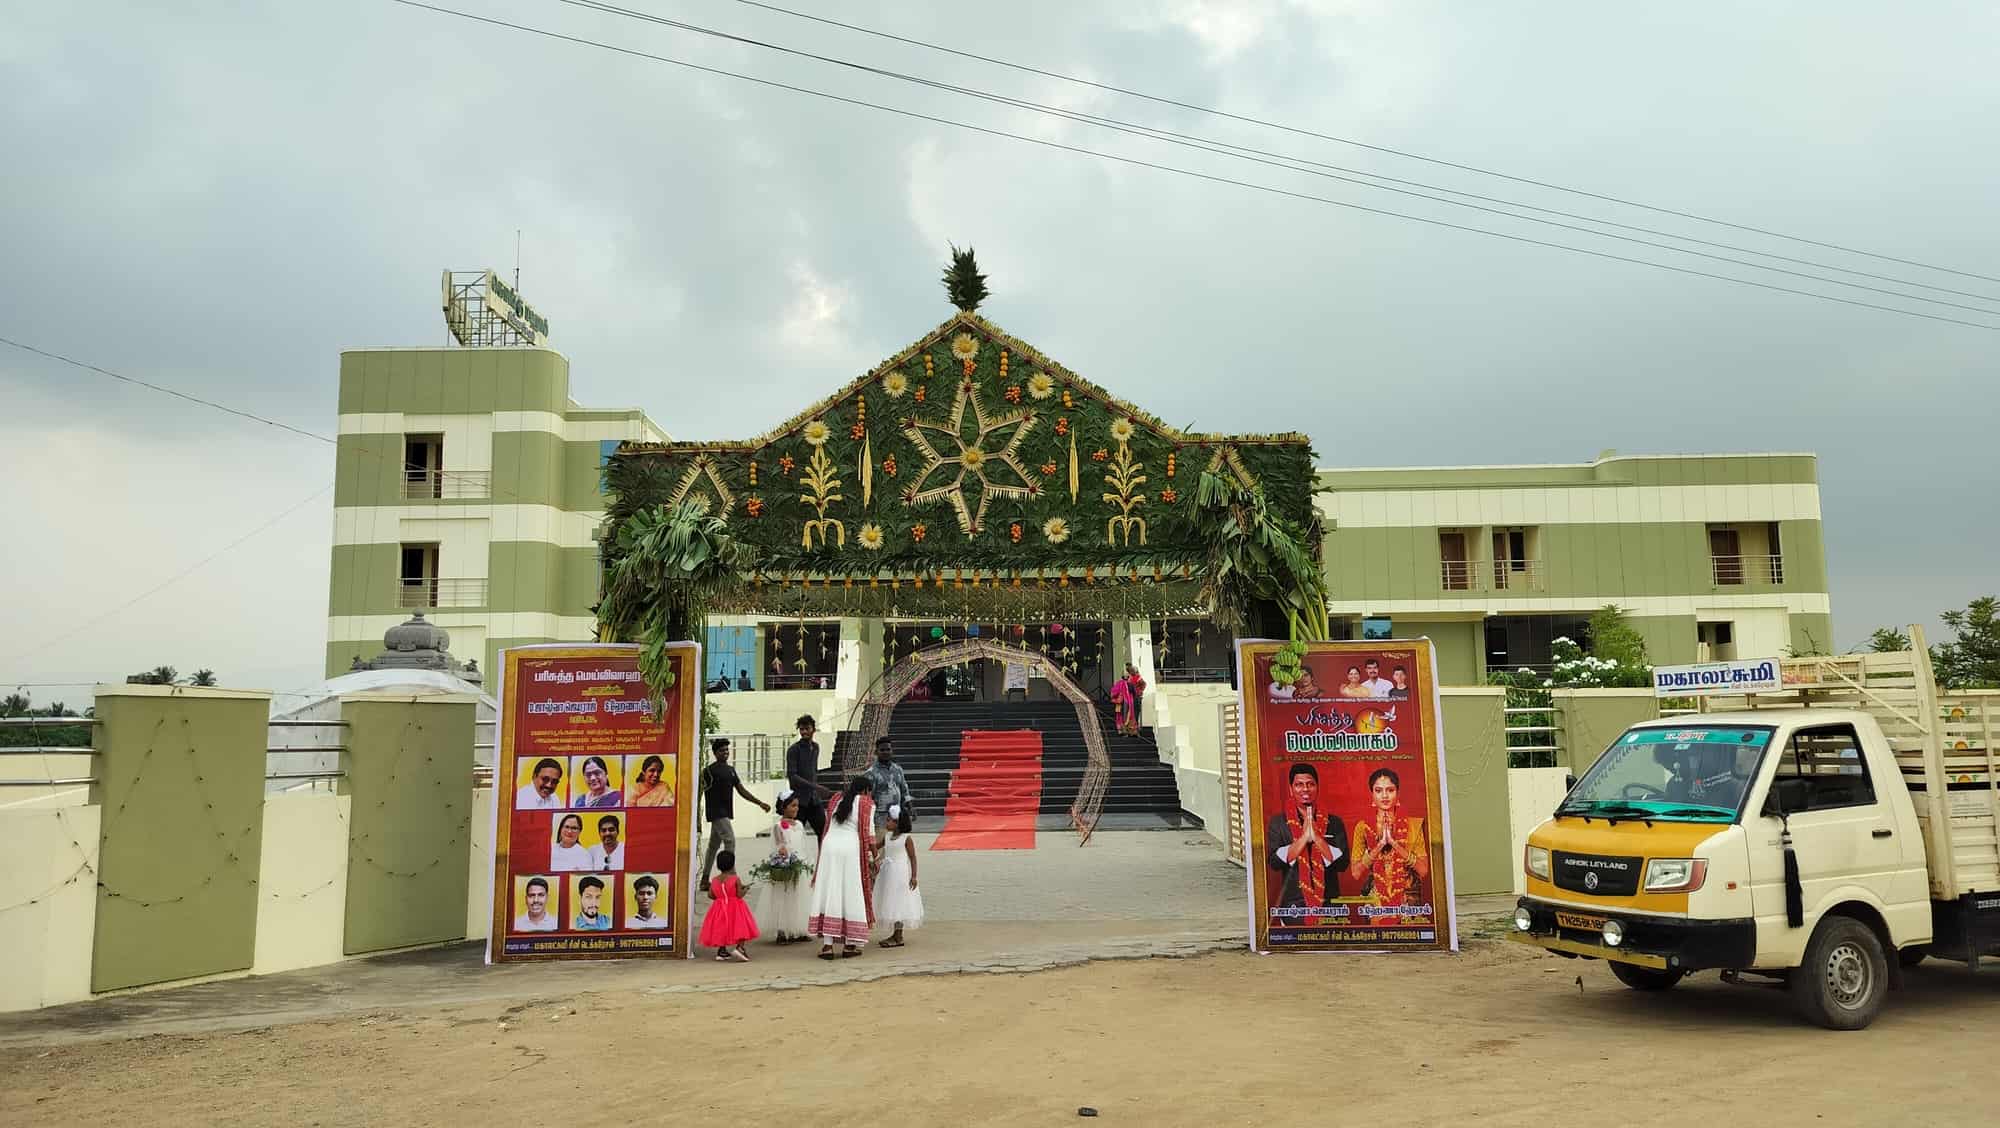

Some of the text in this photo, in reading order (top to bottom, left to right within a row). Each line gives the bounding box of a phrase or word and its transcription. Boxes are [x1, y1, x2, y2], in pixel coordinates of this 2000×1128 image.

[1656, 662, 1775, 687] மகாலட்சுமி
[1296, 705, 1354, 730] பரிசுத்த
[1285, 728, 1398, 752] மெய்விவாகம்
[1564, 858, 1628, 870] ASHOK LEYLAND
